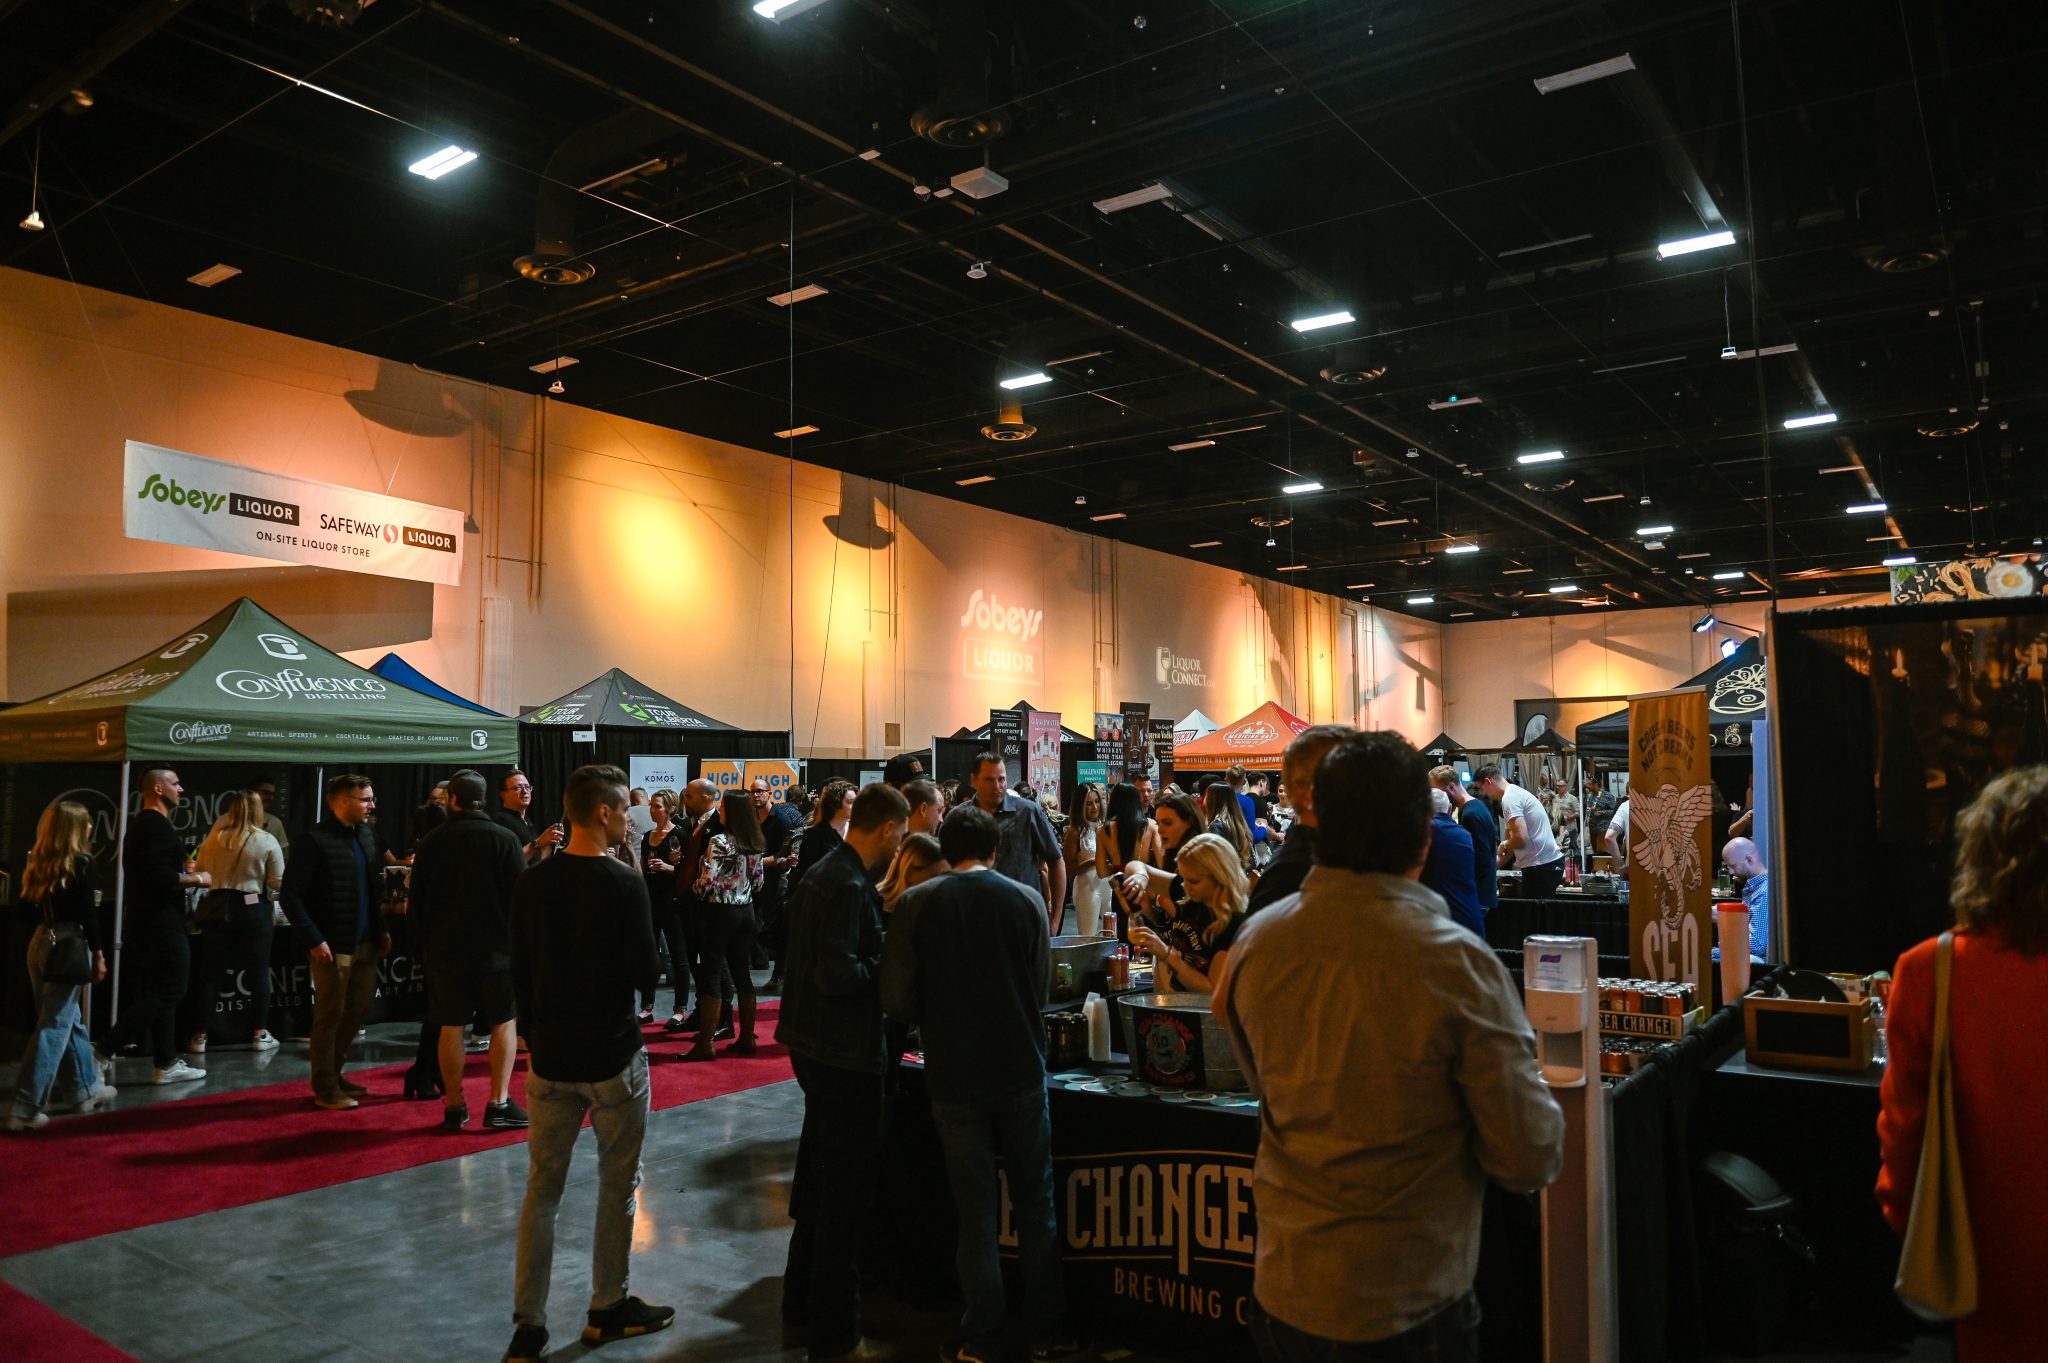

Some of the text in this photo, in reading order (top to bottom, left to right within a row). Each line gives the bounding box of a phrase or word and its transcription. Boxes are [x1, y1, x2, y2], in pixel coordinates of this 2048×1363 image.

[138, 474, 226, 514] Sobeys
[237, 499, 293, 521] LIQUOR
[320, 514, 381, 539] SAFEWAY
[256, 531, 370, 558] ON-SITE LIQUOR STORE
[408, 531, 451, 549] LIQUOR
[961, 588, 1043, 641] Sobeys
[974, 647, 1034, 673] LIQUOR
[1171, 654, 1201, 672] LIQUOR
[645, 708, 678, 717] TOUR
[1638, 719, 1697, 752] CRUSH BEERS
[1641, 744, 1658, 773] NOT
[707, 772, 739, 786] HIGH
[1623, 1015, 1669, 1035] CHANGE
[1066, 1162, 1254, 1277] CHANGE
[1114, 1266, 1221, 1320] BREWING
